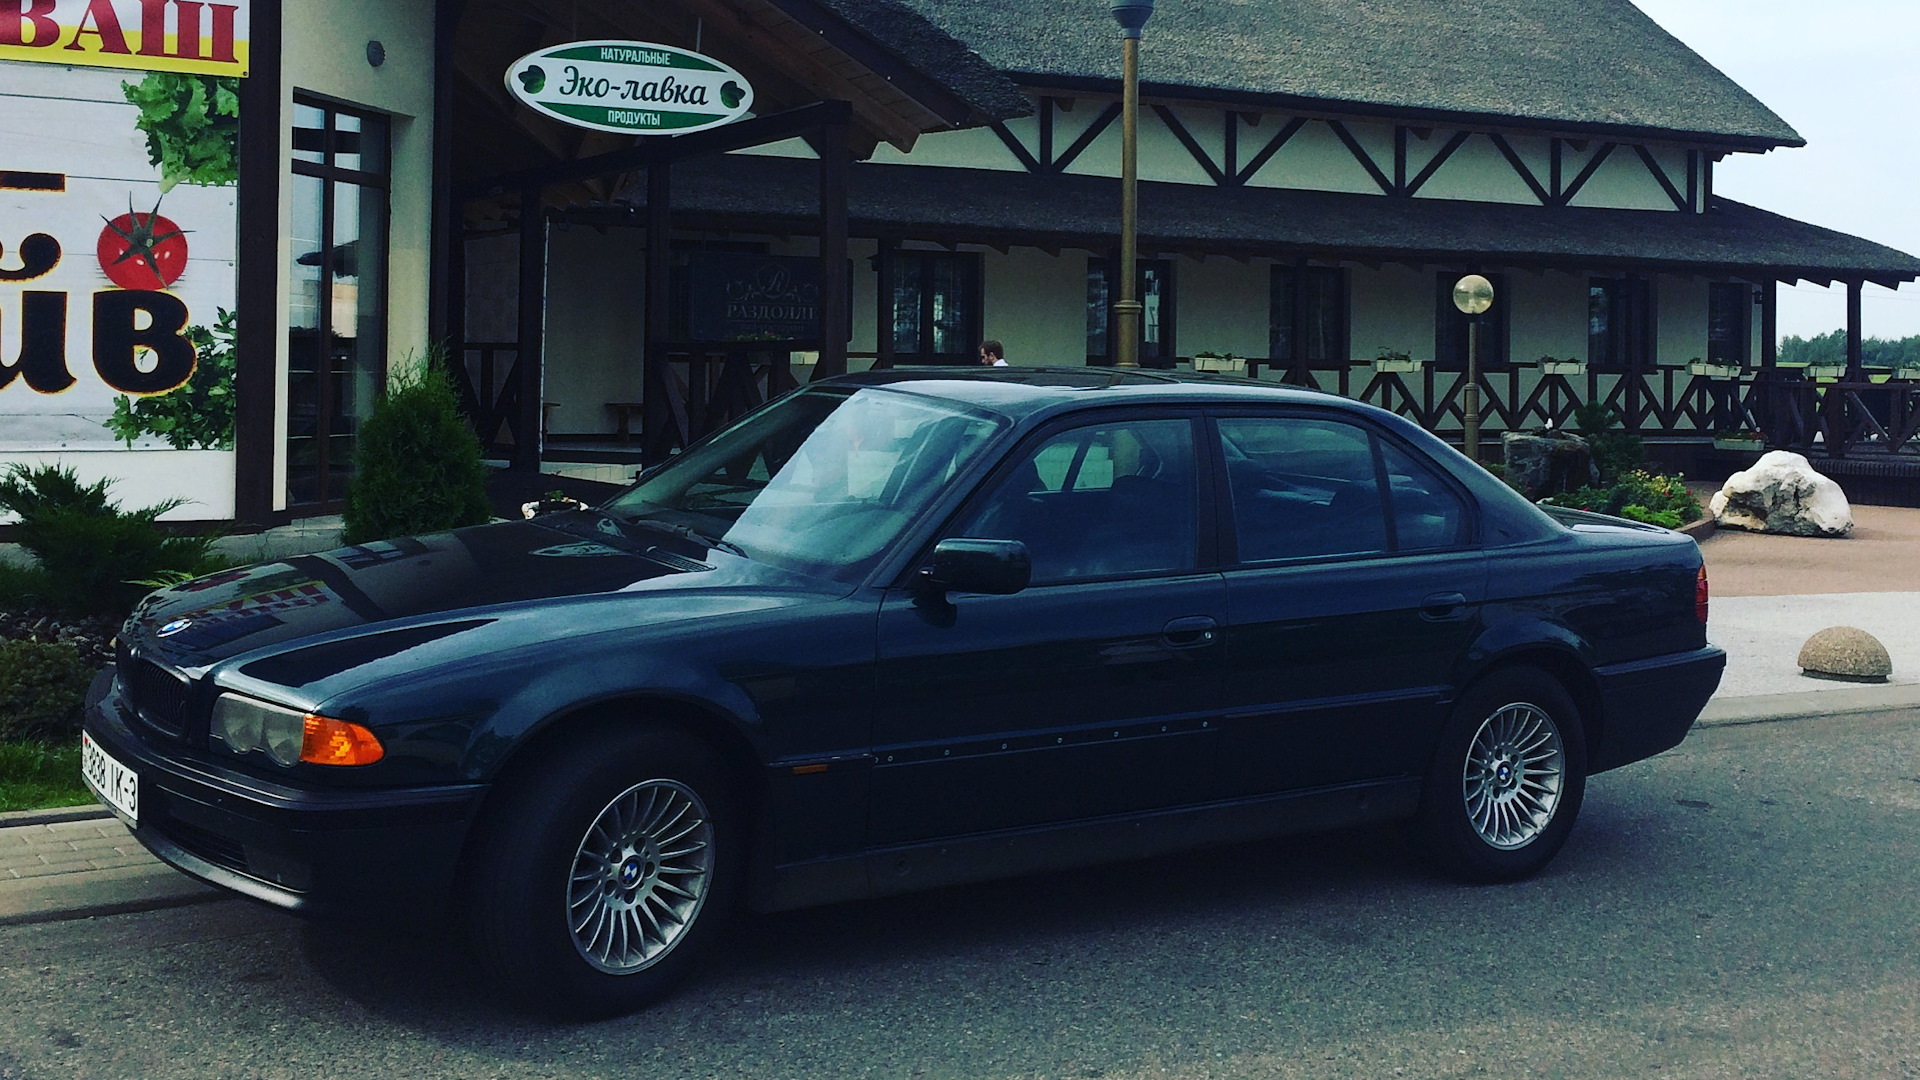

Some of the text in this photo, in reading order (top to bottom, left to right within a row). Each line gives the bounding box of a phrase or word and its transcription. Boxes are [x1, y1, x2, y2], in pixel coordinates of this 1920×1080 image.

[600, 47, 671, 65] НАТУРАЛЬНЫЕ
[559, 65, 709, 106] Эко-лавка
[607, 110, 661, 126] ПРОДУКТЫ
